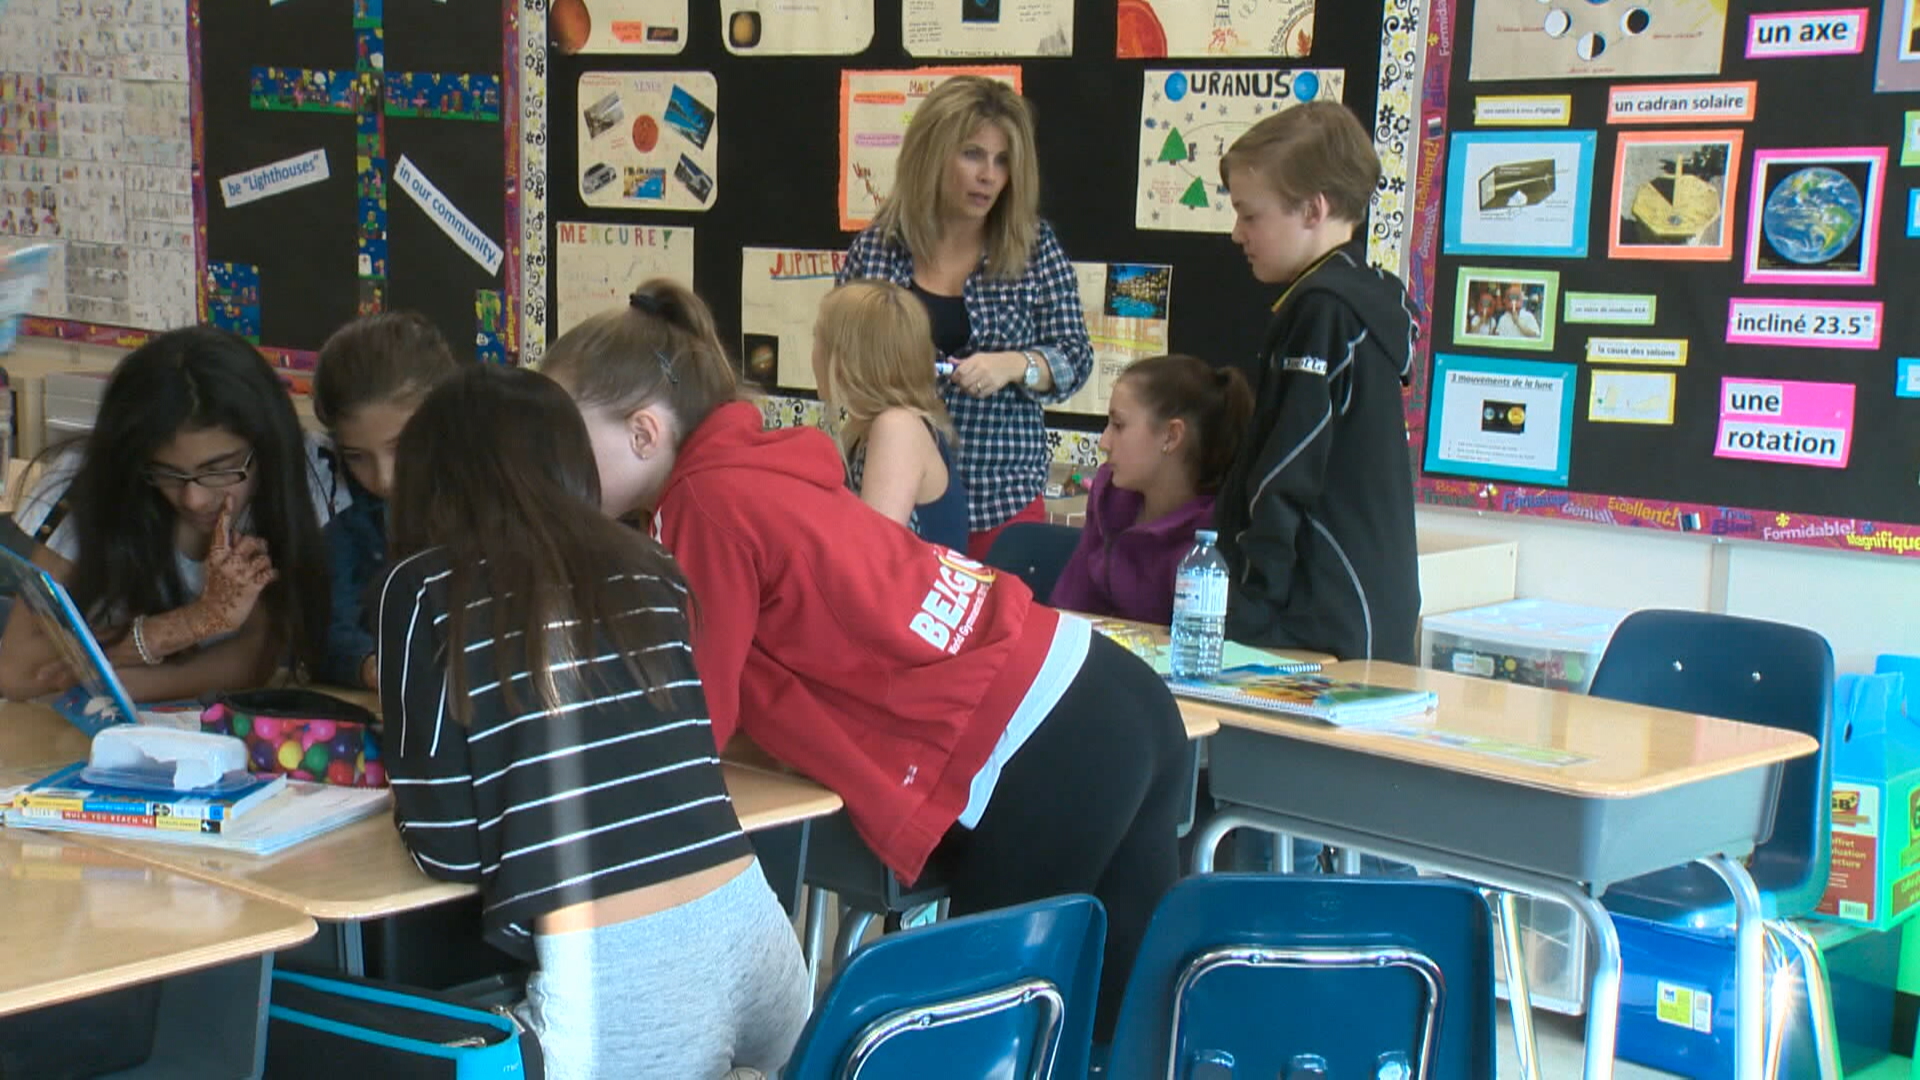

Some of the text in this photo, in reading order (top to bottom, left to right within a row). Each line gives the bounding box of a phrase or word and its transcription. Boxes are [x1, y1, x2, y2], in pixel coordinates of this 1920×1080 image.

[1758, 22, 1848, 44] un axe
[1191, 70, 1291, 98] URANUS
[1615, 94, 1744, 112] un cadran solaire
[227, 182, 242, 197] be
[399, 163, 497, 266] in our community.
[1736, 312, 1871, 335] incliné 23.5°
[1598, 345, 1676, 357] la cause des saisons
[1458, 375, 1510, 387] mouvements
[1512, 378, 1524, 388] de
[1525, 379, 1533, 389] la
[1534, 380, 1553, 391] lune
[1731, 393, 1780, 412] une
[1727, 430, 1836, 455] rotation
[1608, 496, 1680, 527] Excellent!
[1763, 519, 1856, 540] Formidable!
[1846, 531, 1920, 554] Magnifique
[909, 550, 983, 652] BELG
